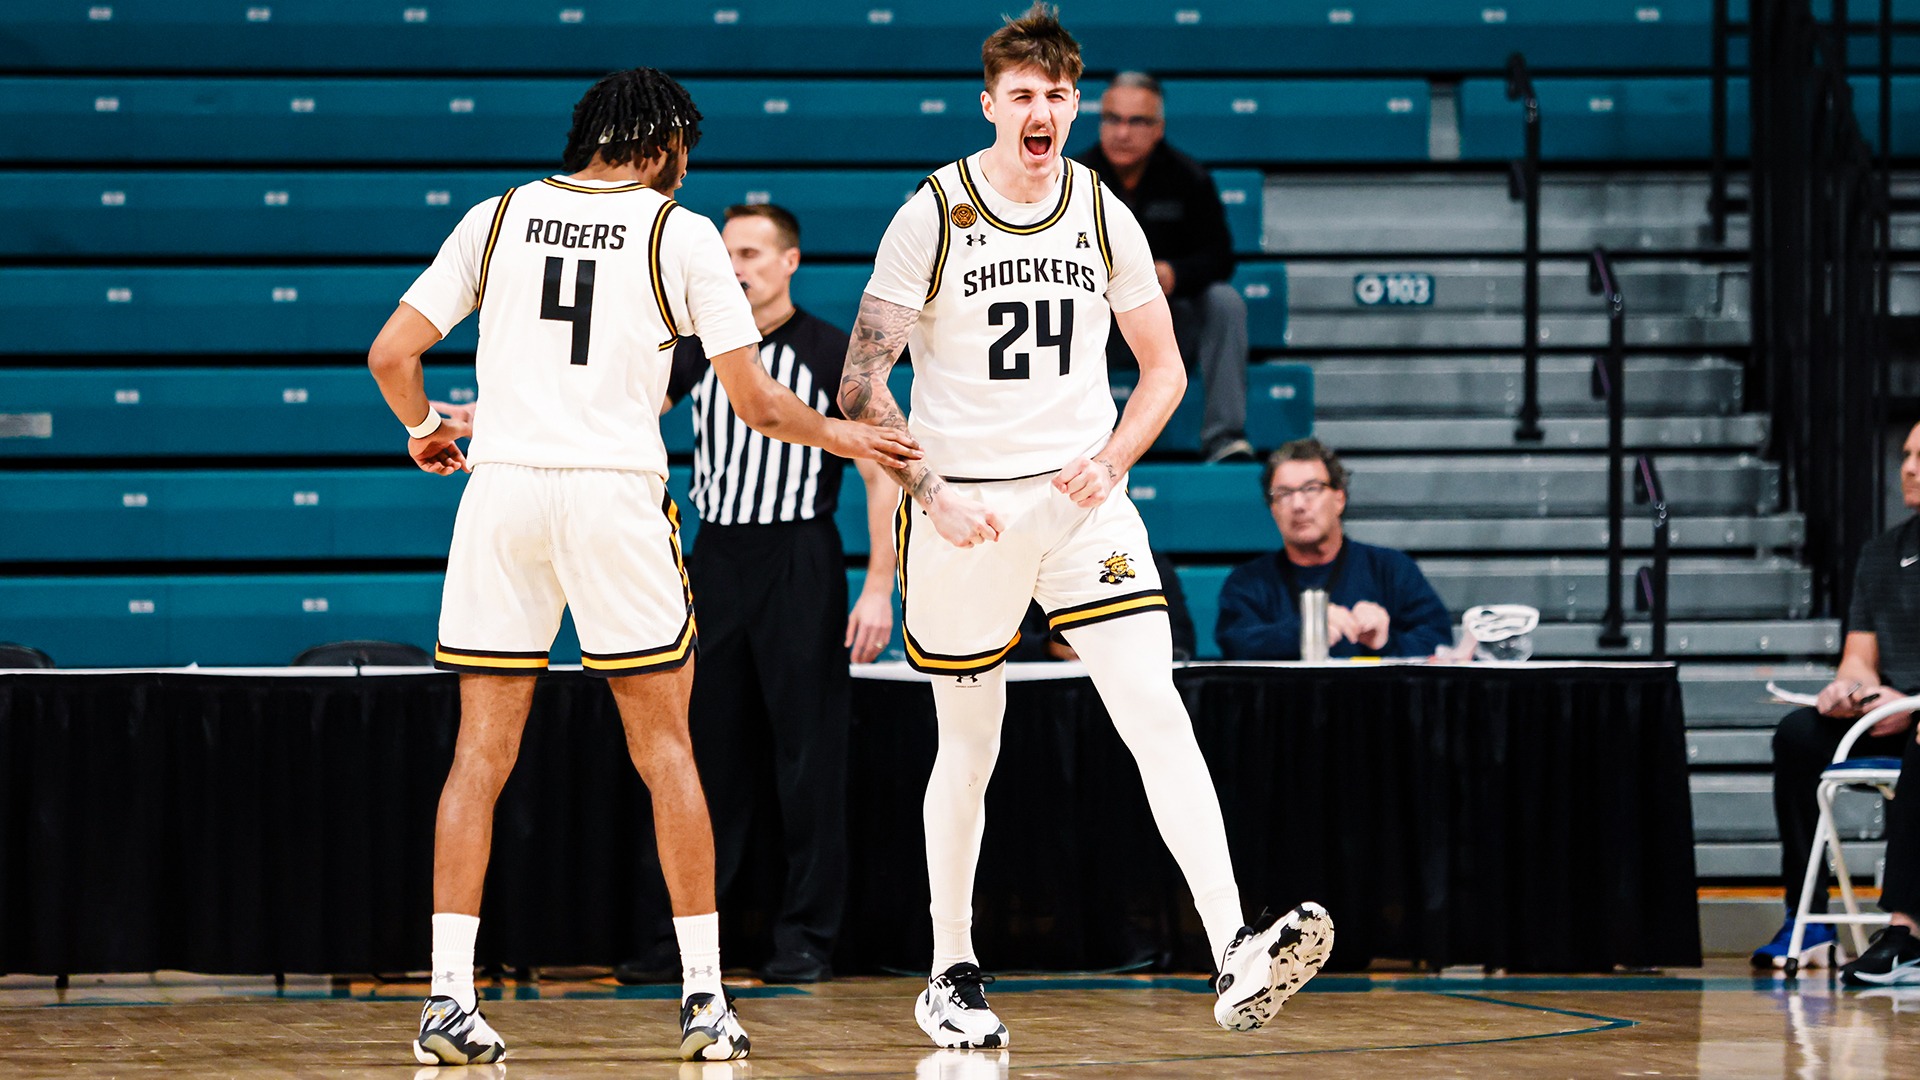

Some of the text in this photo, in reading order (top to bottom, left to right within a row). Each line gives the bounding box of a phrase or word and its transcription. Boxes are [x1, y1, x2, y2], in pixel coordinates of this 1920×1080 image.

[525, 218, 627, 250] ROGERS
[963, 258, 1096, 298] SHOCKERS
[539, 255, 597, 366] 4
[987, 298, 1074, 380] 24
